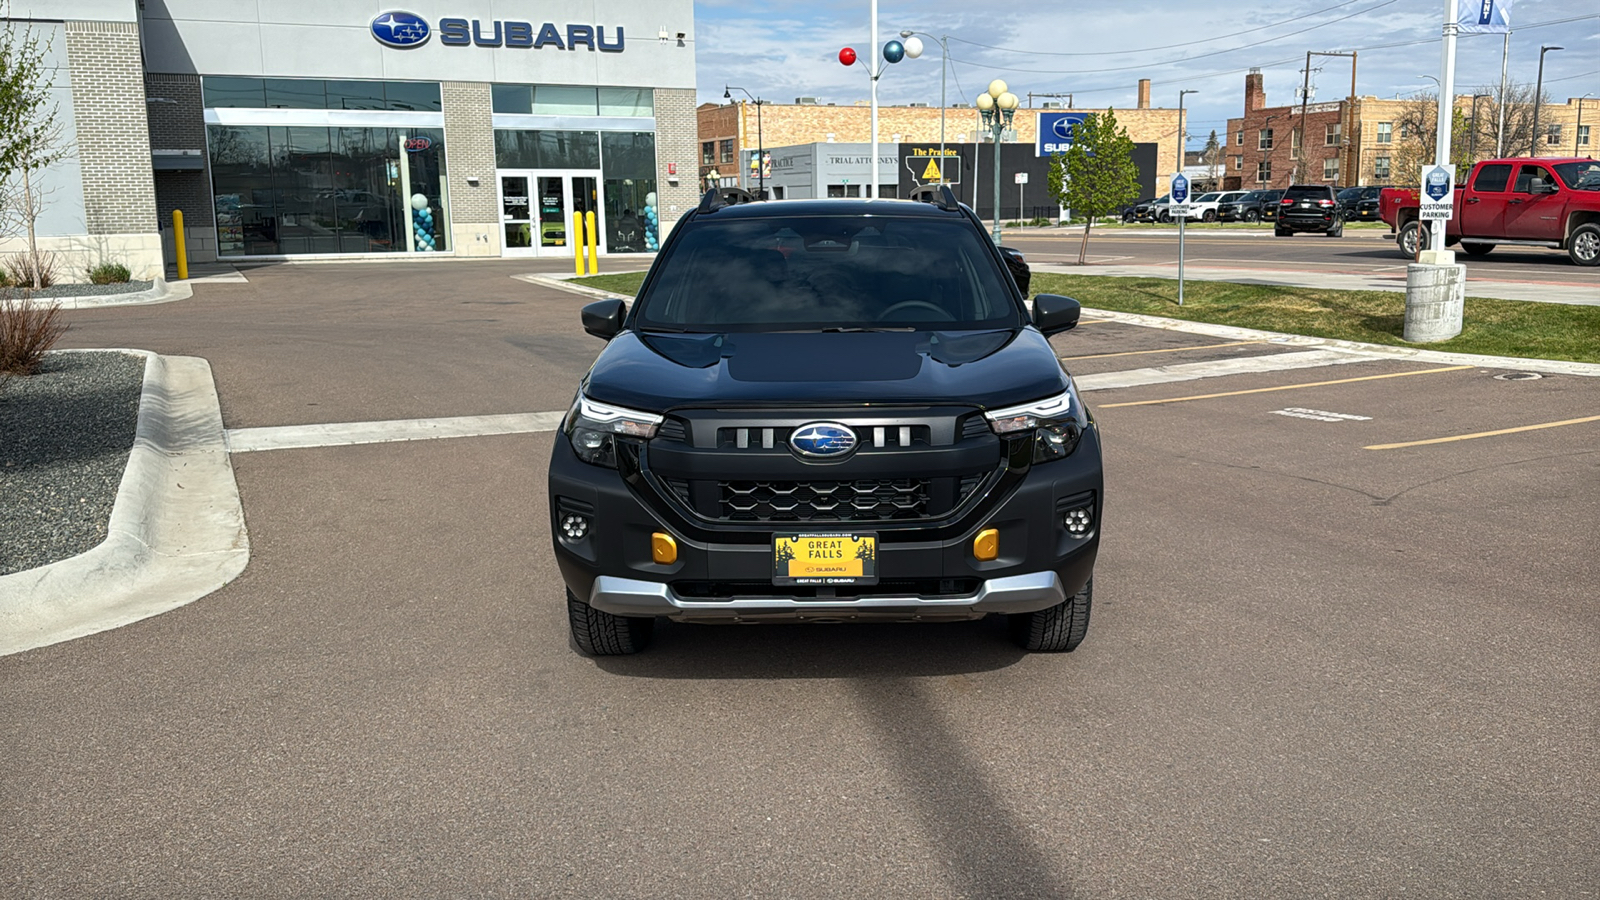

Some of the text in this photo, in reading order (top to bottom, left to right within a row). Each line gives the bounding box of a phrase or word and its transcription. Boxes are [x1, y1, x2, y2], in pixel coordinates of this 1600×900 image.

[439, 18, 625, 52] SUBARU
[404, 139, 429, 149] OPEN
[1044, 143, 1092, 152] SUB
[912, 148, 957, 156] The Pratice
[808, 541, 842, 549] GREAT
[808, 550, 843, 559] FALLS
